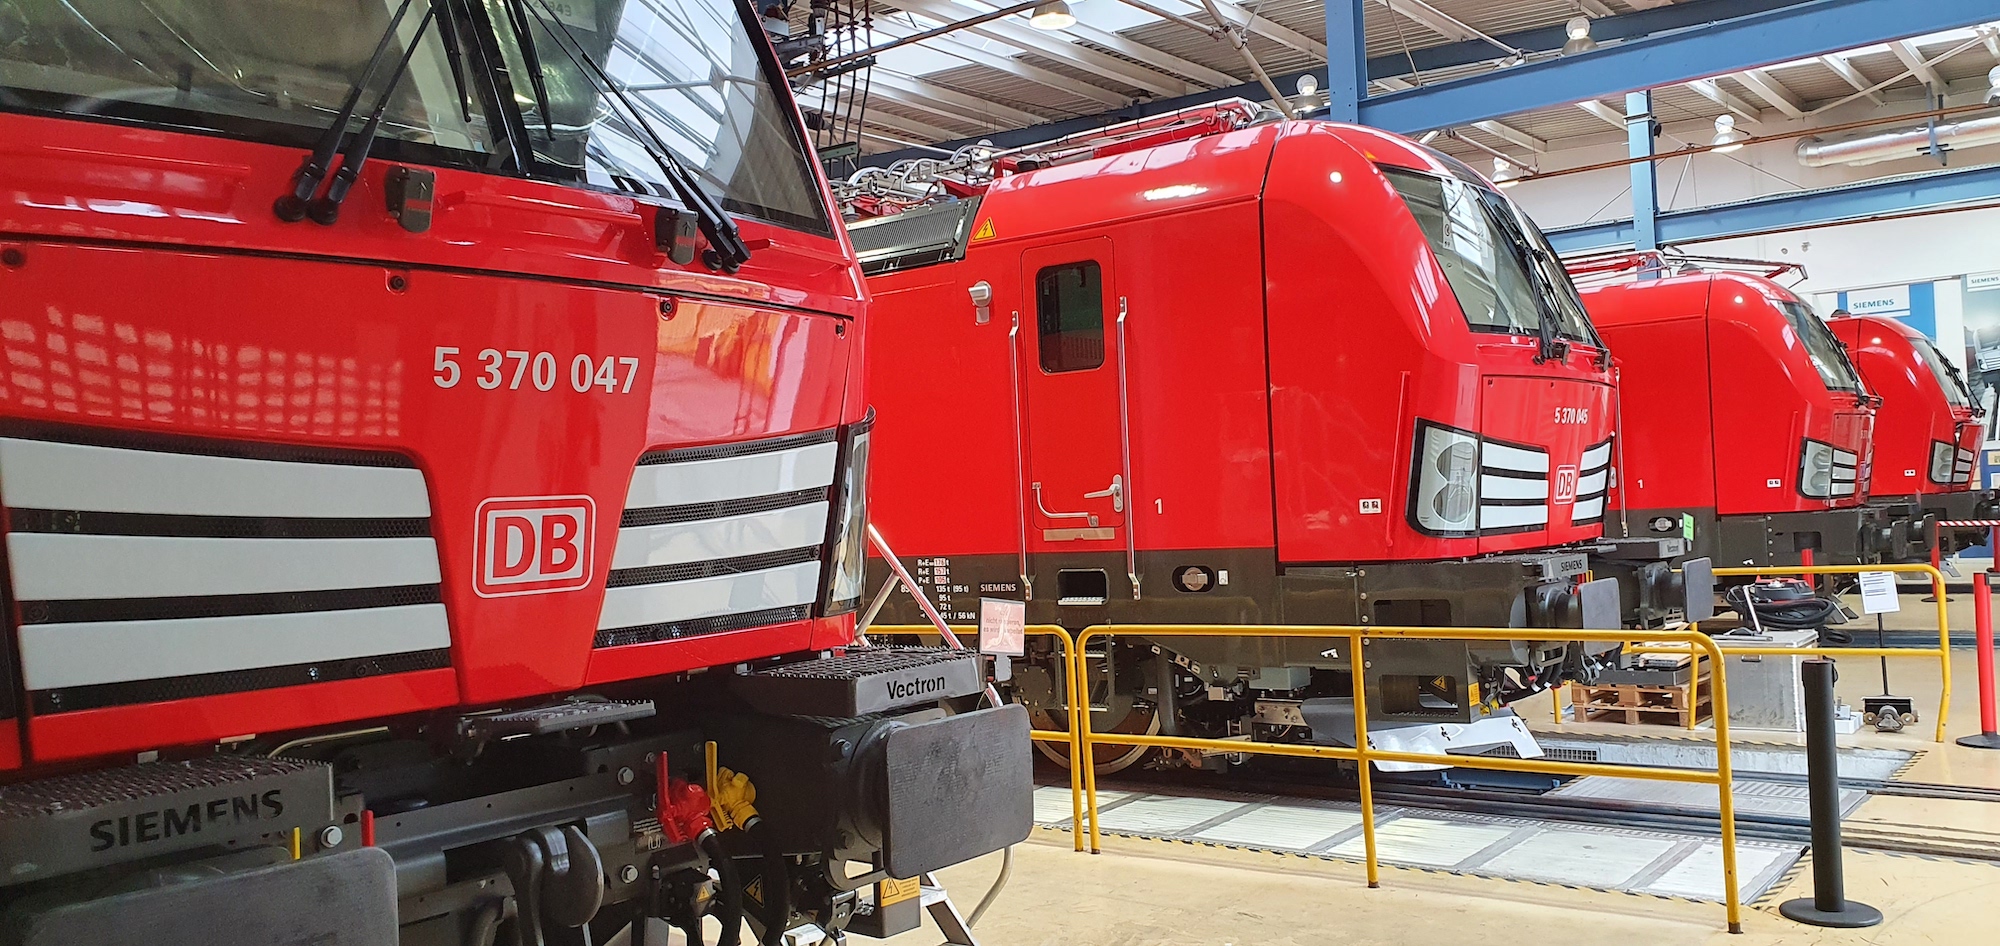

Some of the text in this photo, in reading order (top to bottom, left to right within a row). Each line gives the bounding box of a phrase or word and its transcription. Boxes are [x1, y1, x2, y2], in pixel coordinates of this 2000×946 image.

[1853, 299, 1895, 309] SIEMENS
[433, 346, 640, 394] 5 370 047
[1553, 407, 1589, 424] 5 370 045
[1558, 472, 1573, 497] DB
[1637, 479, 1643, 489] 1
[1154, 498, 1163, 515] 1
[493, 513, 580, 578] DB
[1560, 559, 1583, 572] SIEMENS
[935, 585, 947, 593] 135
[980, 583, 1017, 592] SIEMENS
[938, 594, 947, 602] 95
[939, 603, 947, 611] 72
[886, 676, 946, 700] Vectron
[89, 789, 284, 853] SIEMENS
